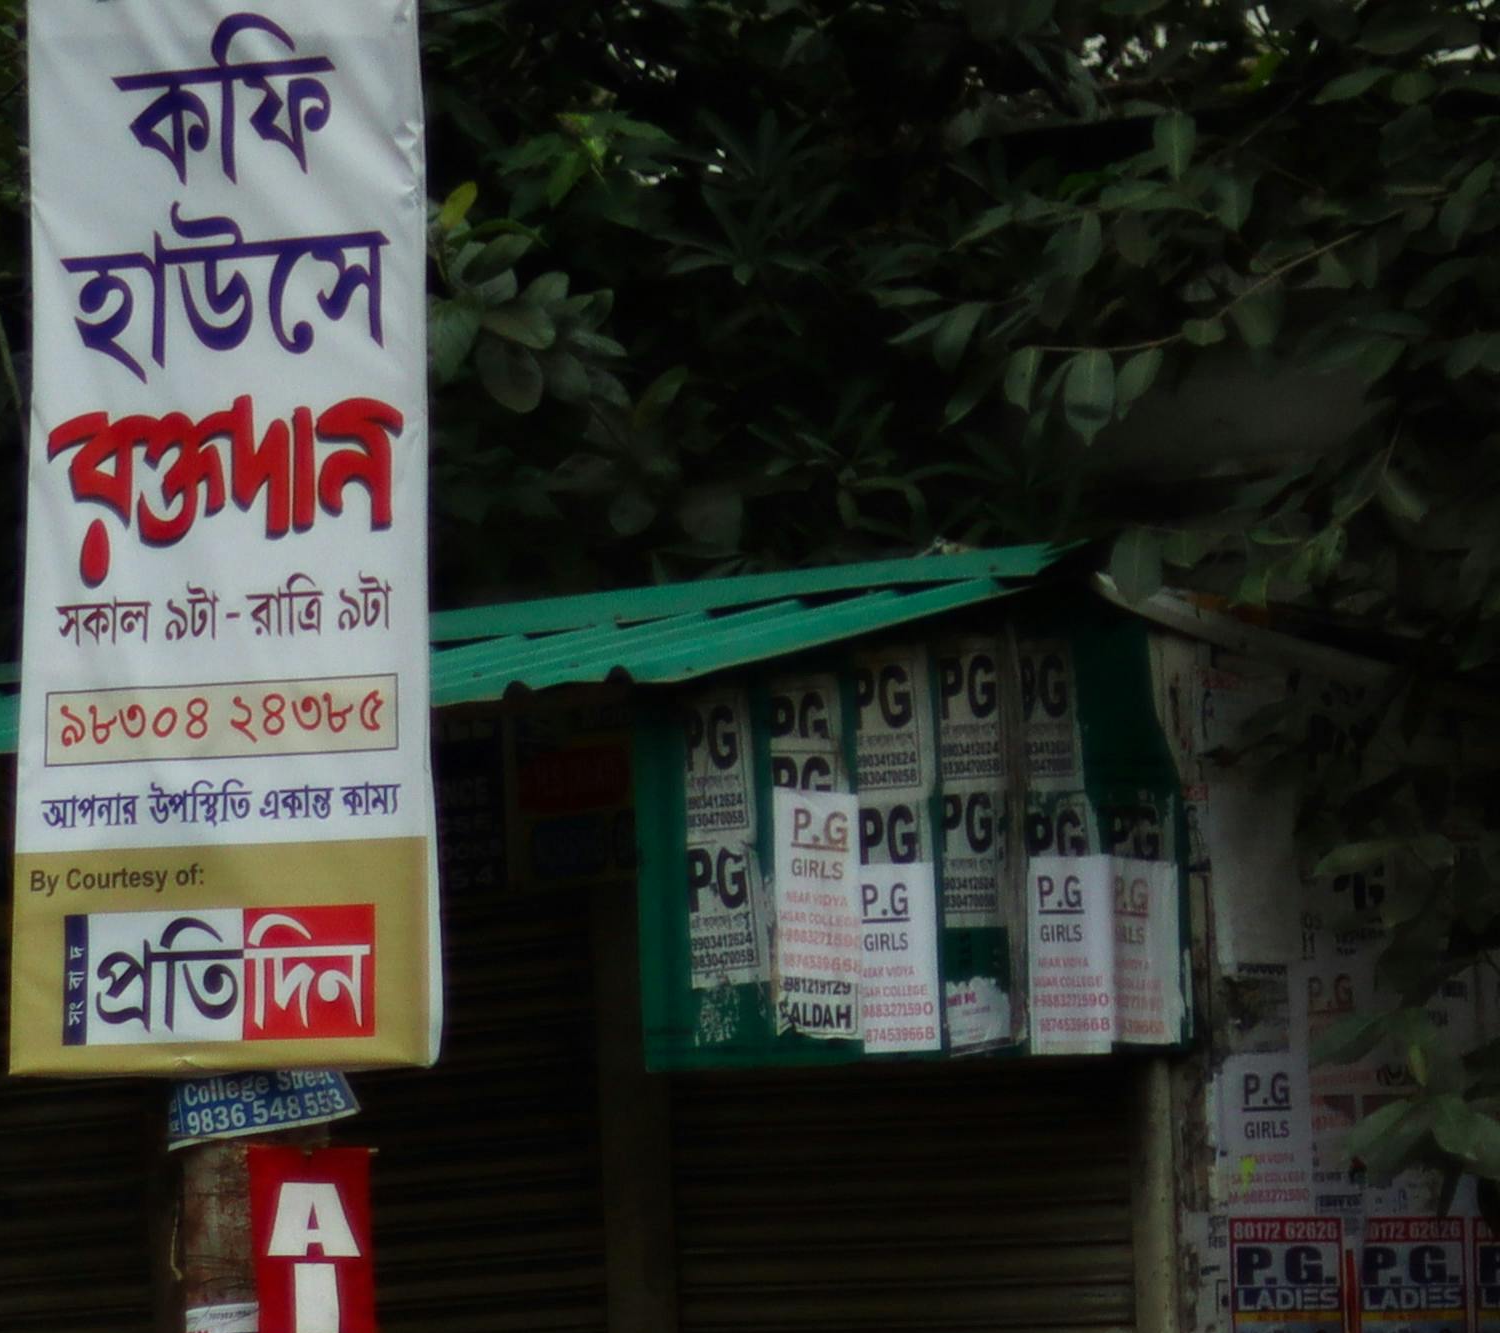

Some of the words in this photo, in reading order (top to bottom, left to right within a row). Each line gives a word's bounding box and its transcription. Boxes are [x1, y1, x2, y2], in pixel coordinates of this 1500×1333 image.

[111, 11, 336, 186] কফি
[59, 201, 390, 384] হাউসে
[47, 393, 404, 589] রক্তদান
[56, 598, 152, 647] সকাল
[164, 583, 220, 642] ৯টা
[245, 572, 324, 637] রাত্রি
[337, 570, 392, 632] ৯টা
[856, 665, 912, 730] PG
[60, 696, 210, 748] ৯৮৩০৪
[229, 688, 386, 743] ২৪৩৮৫
[42, 793, 140, 831] আপনার
[859, 805, 916, 865] PG
[30, 867, 56, 896] By
[66, 864, 168, 893] Courtesy
[174, 864, 206, 888] of:
[688, 848, 747, 913] PG
[791, 858, 843, 880] GIRLS
[862, 883, 908, 916] P.G
[1037, 876, 1082, 908] P.G
[864, 933, 908, 951] GIRLS
[1041, 925, 1082, 942] GIRLS
[95, 912, 373, 1033] প্রতিদিন
[184, 1072, 270, 1108] College
[1244, 1073, 1290, 1106] P.G
[187, 1102, 247, 1137] 9836
[252, 1095, 302, 1126] 548
[306, 1088, 347, 1115] 553
[1244, 1121, 1290, 1140] GIRLS
[1237, 1246, 1337, 1286] P.G.
[1362, 1246, 1460, 1286] P.G.
[1238, 1287, 1339, 1311] LADIES
[1364, 1287, 1462, 1311] LADIES
